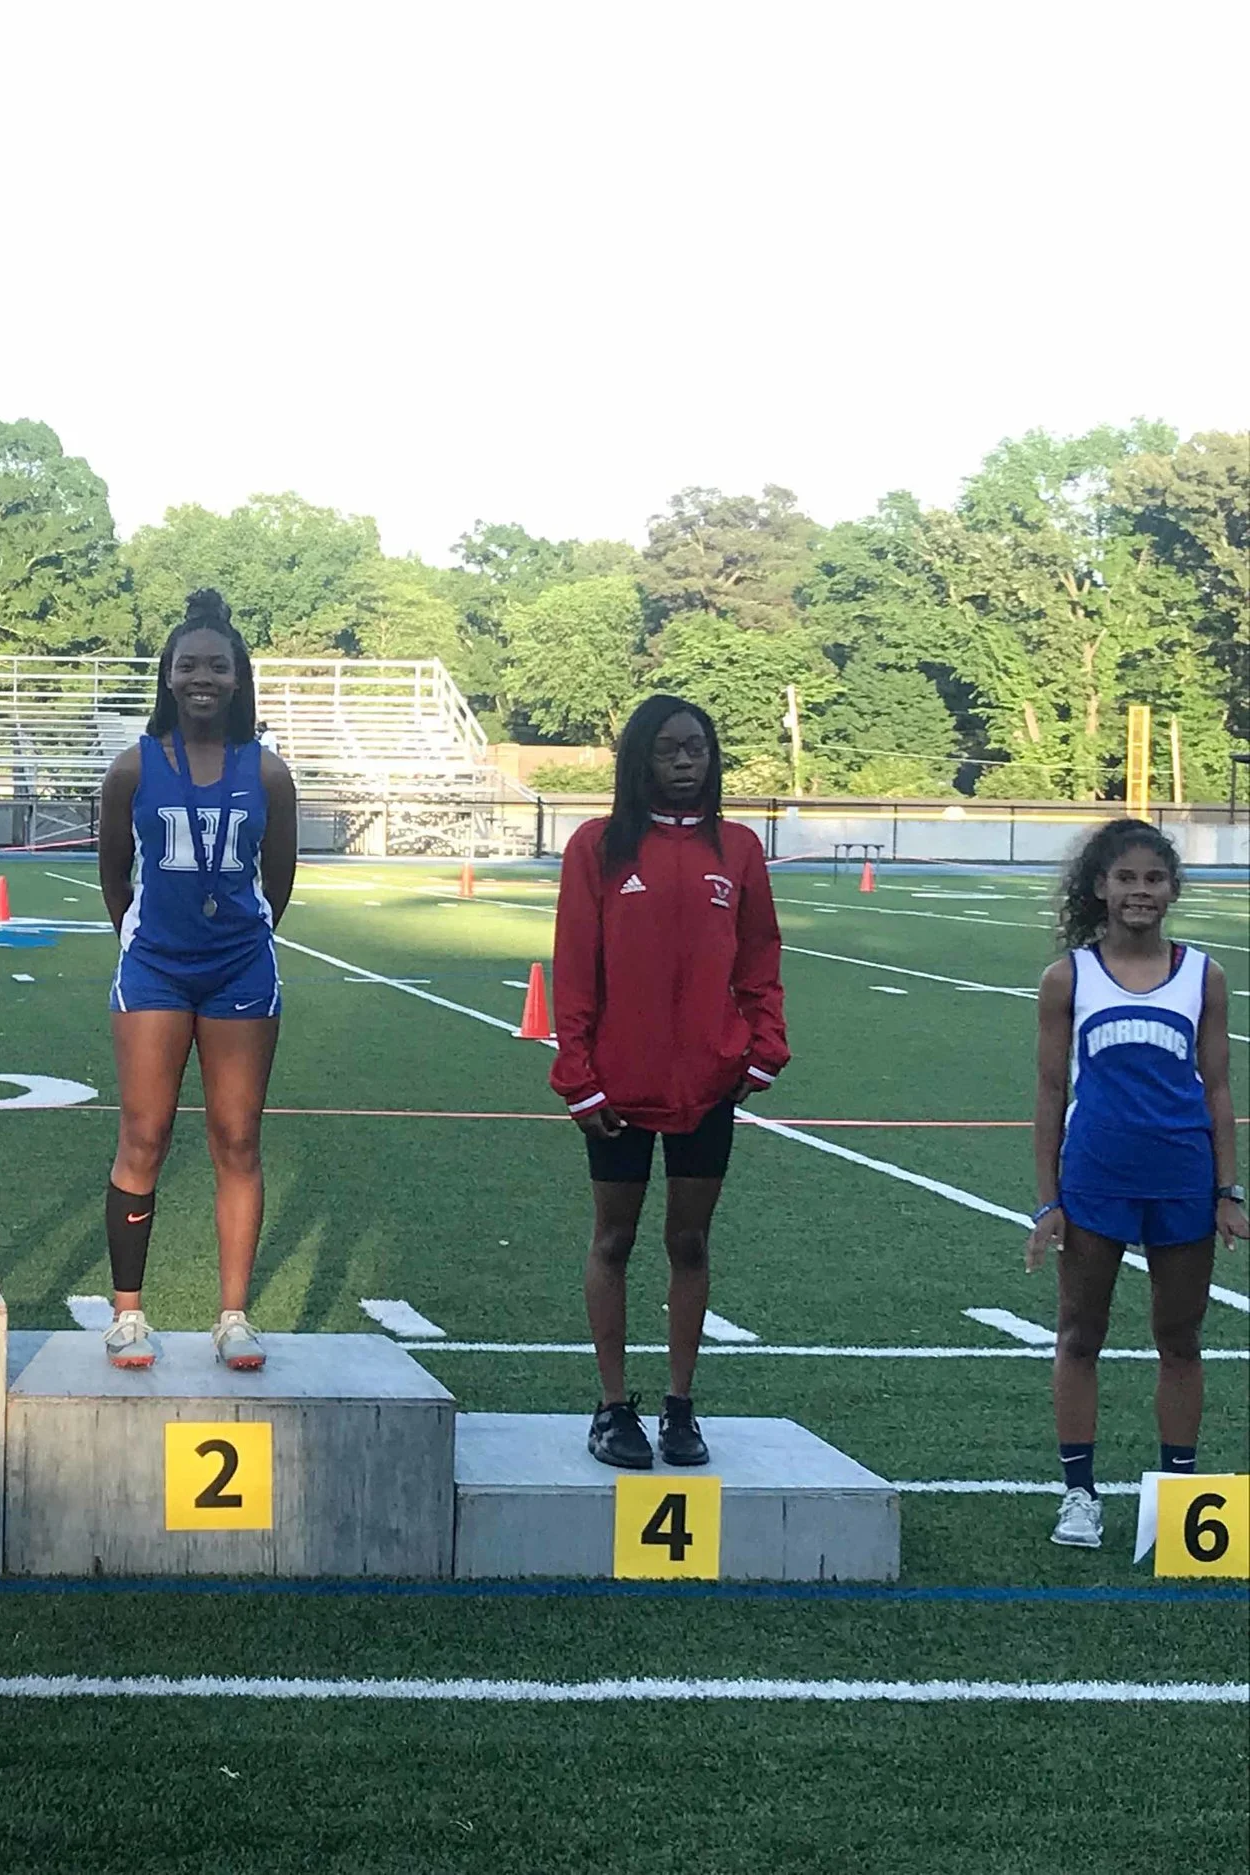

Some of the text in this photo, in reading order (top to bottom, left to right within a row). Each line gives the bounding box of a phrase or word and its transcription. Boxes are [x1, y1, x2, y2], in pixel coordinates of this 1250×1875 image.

[1086, 1018, 1188, 1061] HARDING
[195, 1440, 242, 1508] 2
[641, 1494, 693, 1561] 4
[1184, 1493, 1229, 1562] 6
